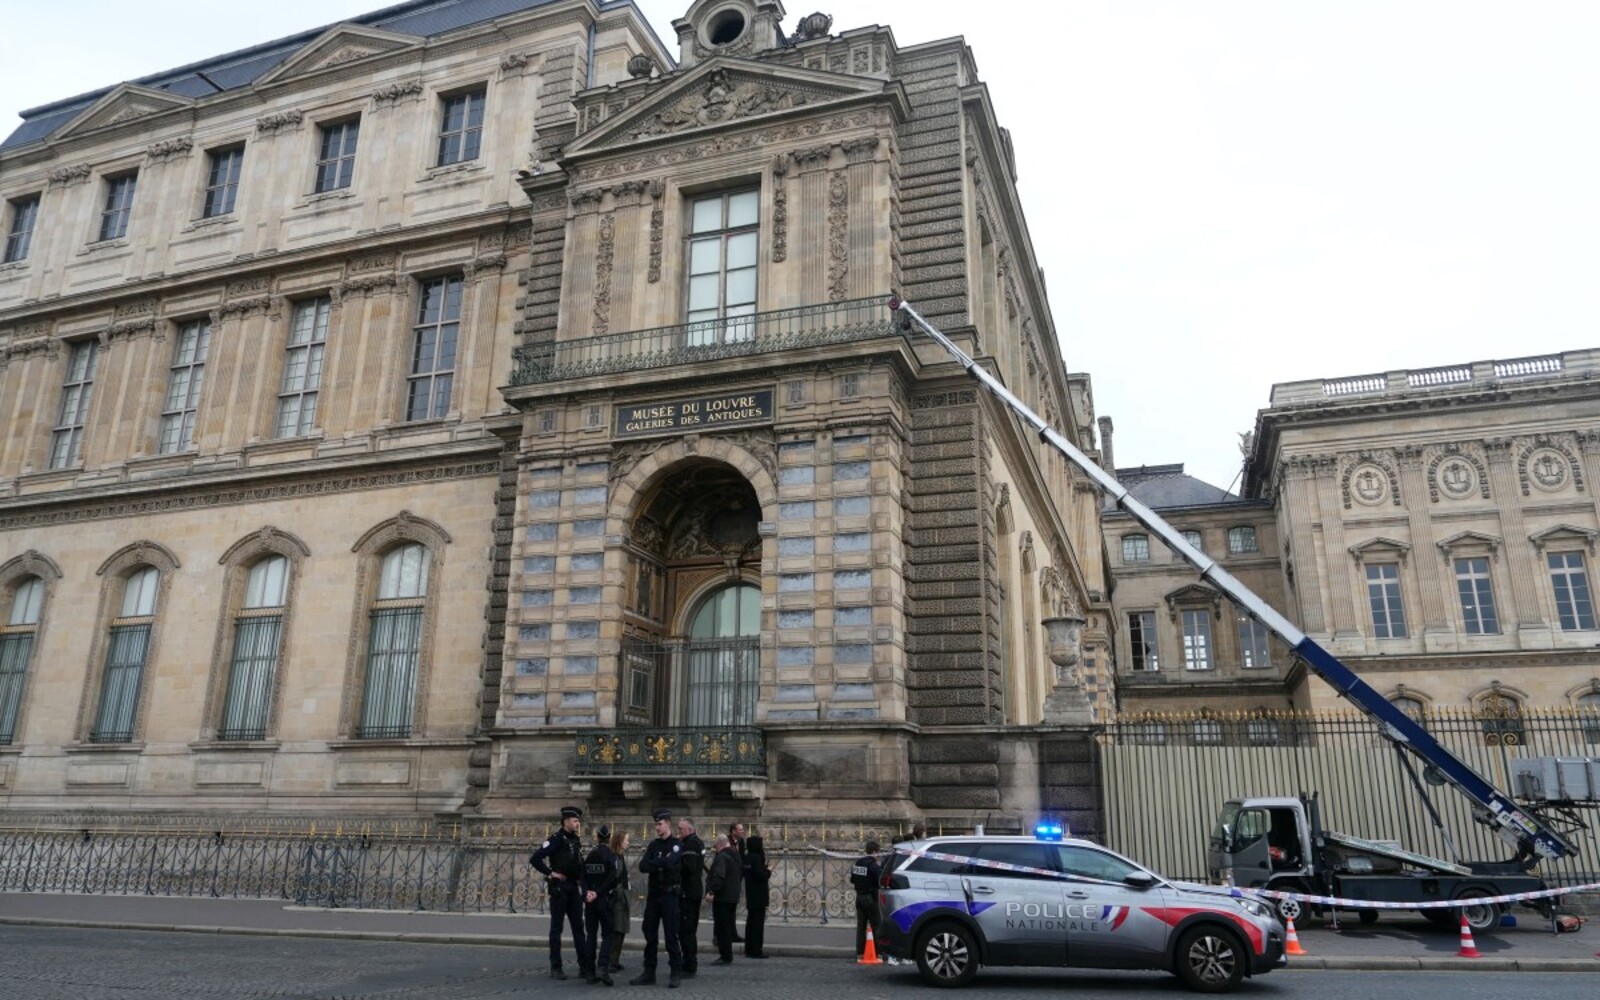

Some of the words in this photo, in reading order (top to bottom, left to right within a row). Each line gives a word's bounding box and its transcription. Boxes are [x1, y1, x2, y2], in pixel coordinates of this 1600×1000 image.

[631, 405, 675, 421] MUSÉE
[682, 402, 700, 414] DU
[706, 396, 757, 412] LOUVRE
[626, 417, 674, 432] GALERIES
[680, 415, 701, 425] DES
[707, 407, 762, 422] ANTIQUES
[1005, 902, 1098, 919] POLICE
[1005, 919, 1099, 931] NATIONALE
